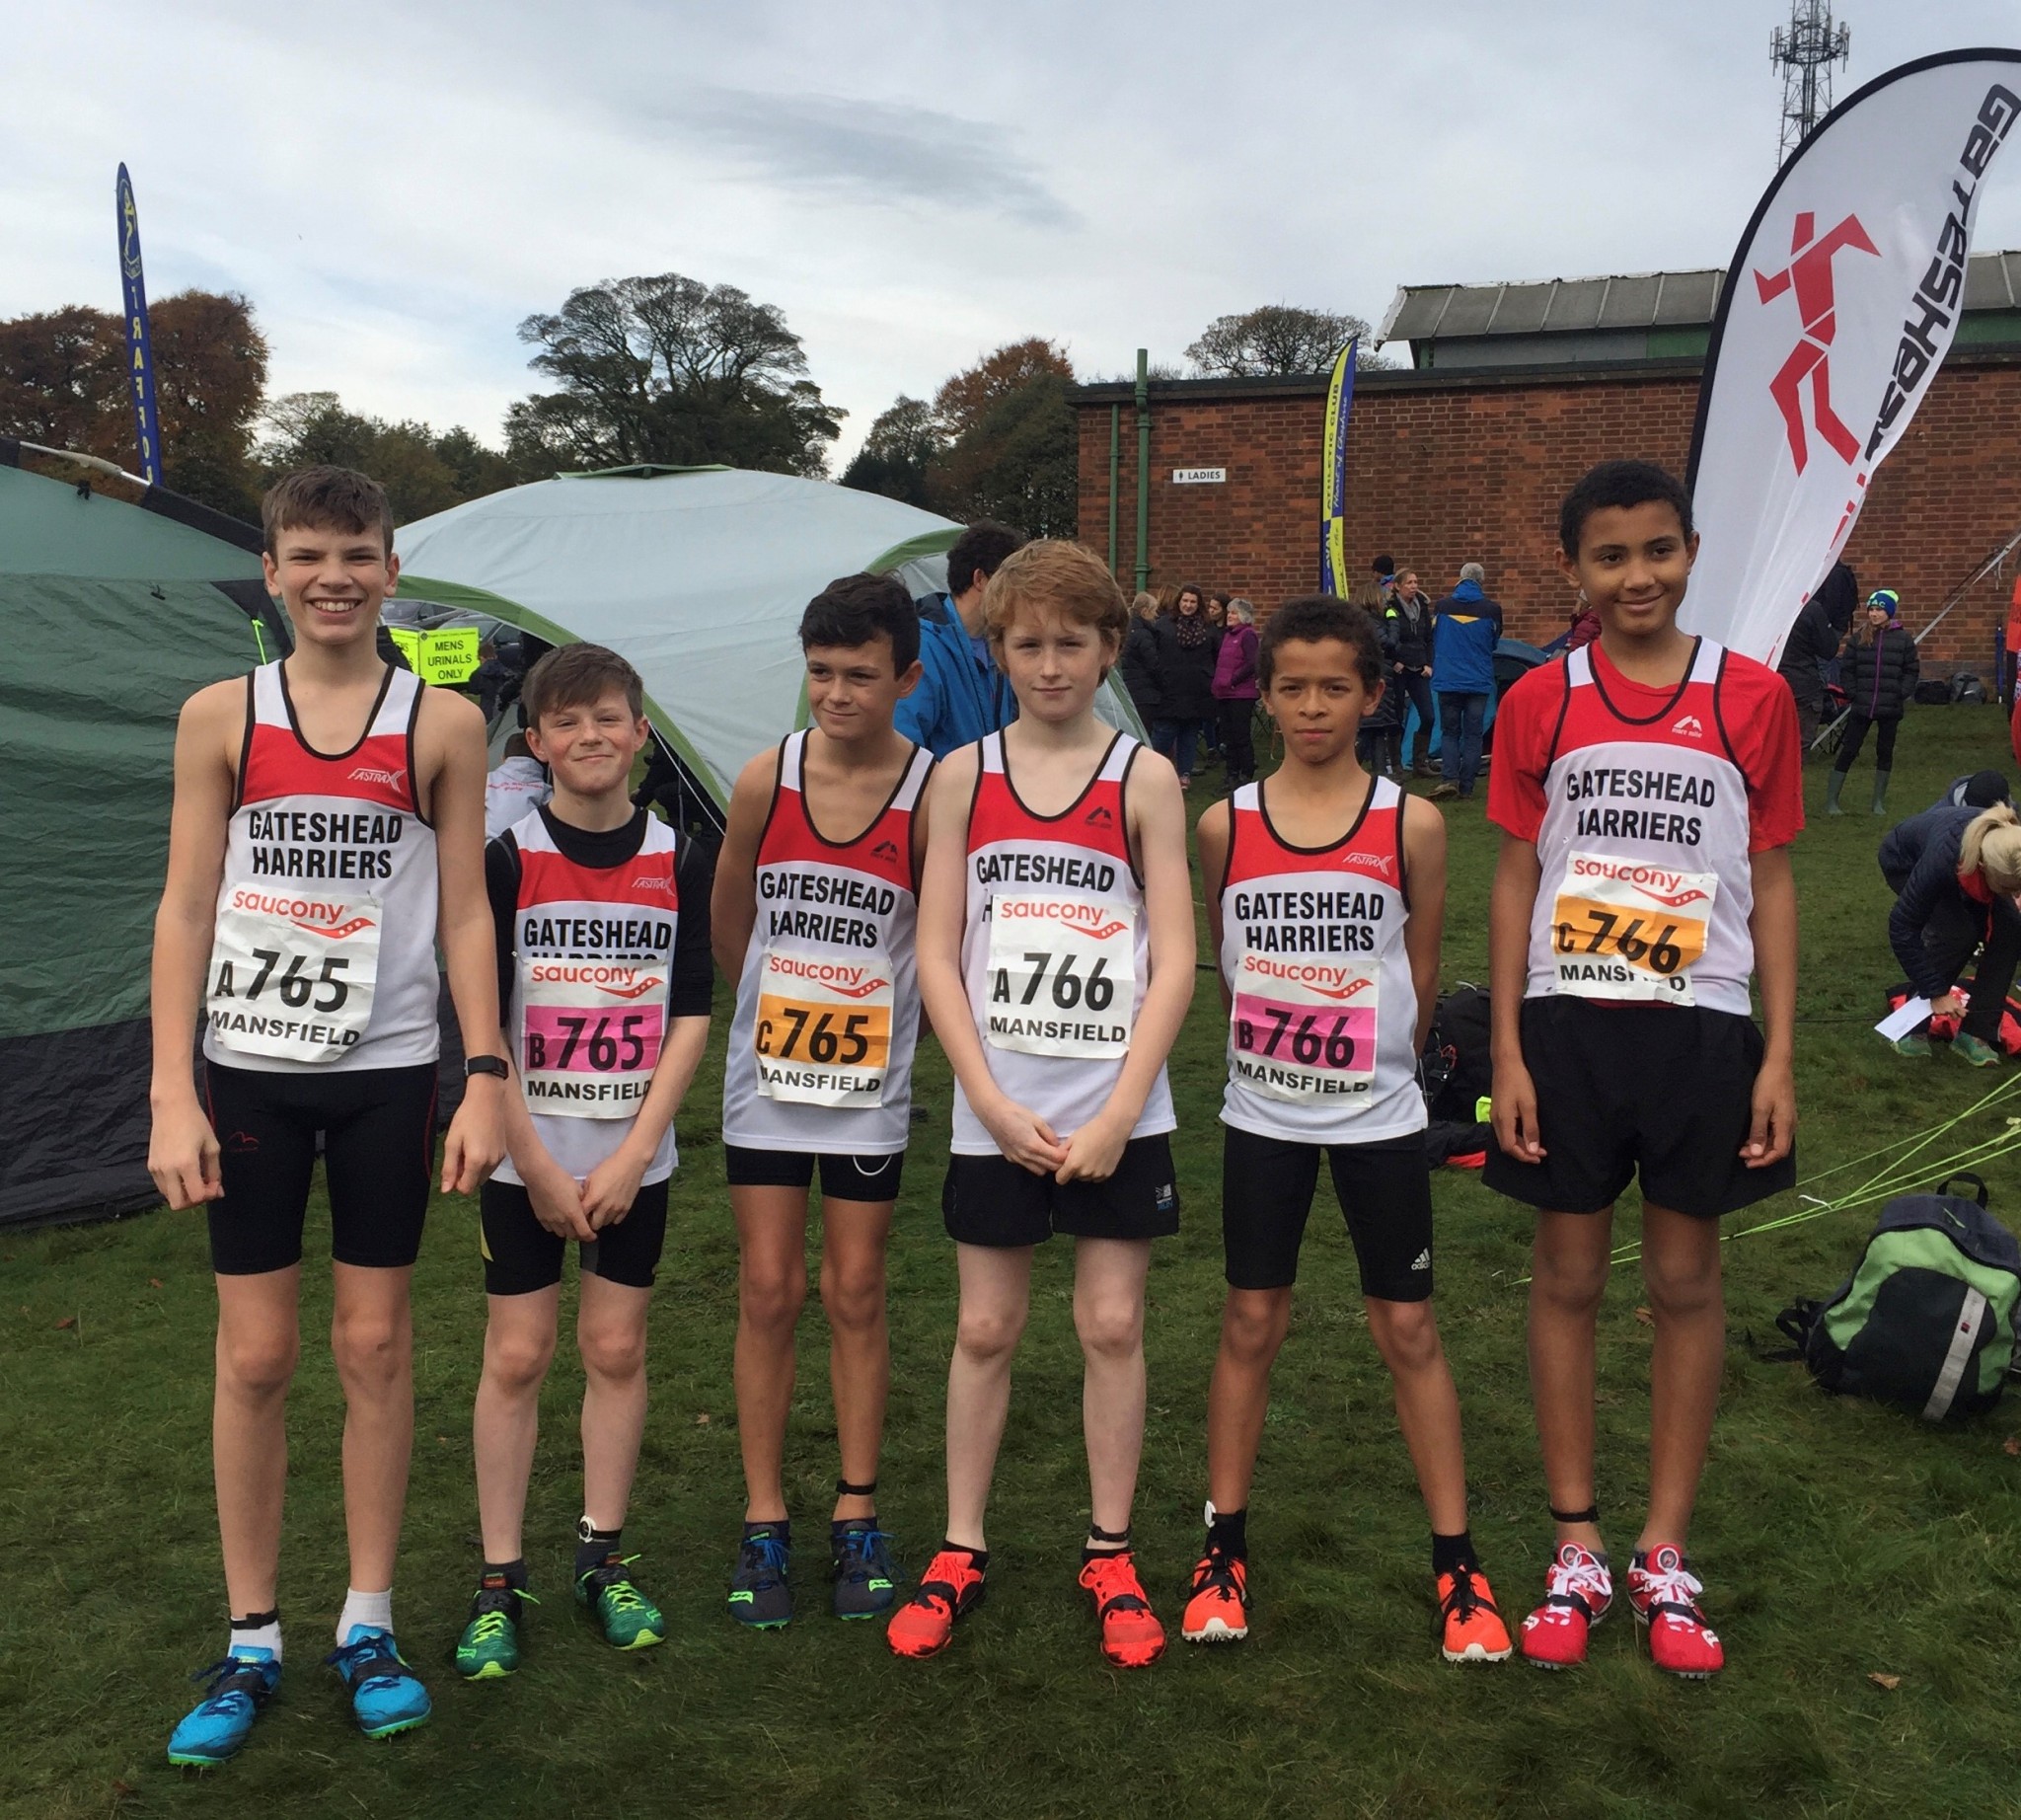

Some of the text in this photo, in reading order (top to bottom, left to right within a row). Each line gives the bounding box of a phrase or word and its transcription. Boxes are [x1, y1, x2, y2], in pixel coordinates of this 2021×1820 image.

[1330, 384, 1339, 426] CLUB
[1188, 471, 1221, 480] LADIES
[427, 653, 472, 666] URINALS
[435, 641, 464, 651] MENS
[438, 669, 464, 680] ONLY
[347, 768, 407, 793] FASTRAX
[1567, 769, 1715, 807] GATESHEAD
[249, 811, 403, 844] GATESHEAD
[253, 847, 392, 878] HARRIERS
[977, 855, 1115, 892] GATESHEAD
[1574, 859, 1682, 893] saucony
[233, 890, 345, 925] saucony
[760, 872, 895, 916] GATESHEAD
[1235, 891, 1385, 920] GATESHEAD
[1001, 901, 1105, 926] saucony
[524, 918, 671, 949] GATESHEAD
[1246, 925, 1375, 951] HARRIERS
[1558, 910, 1682, 974] C 766
[215, 948, 349, 1013] A 765
[532, 965, 636, 986] saucony
[770, 956, 865, 985] saucony
[992, 952, 1114, 1012] A 766
[1244, 955, 1348, 985] saucony
[1560, 964, 1685, 992] MANSD
[211, 1010, 360, 1046] MANSFIELD
[529, 1016, 643, 1071] B 765
[756, 1008, 868, 1064] C 765
[990, 1016, 1126, 1042] MANSFIELD
[1238, 1008, 1355, 1068] B 766
[1236, 1060, 1370, 1094] MANSFIELD
